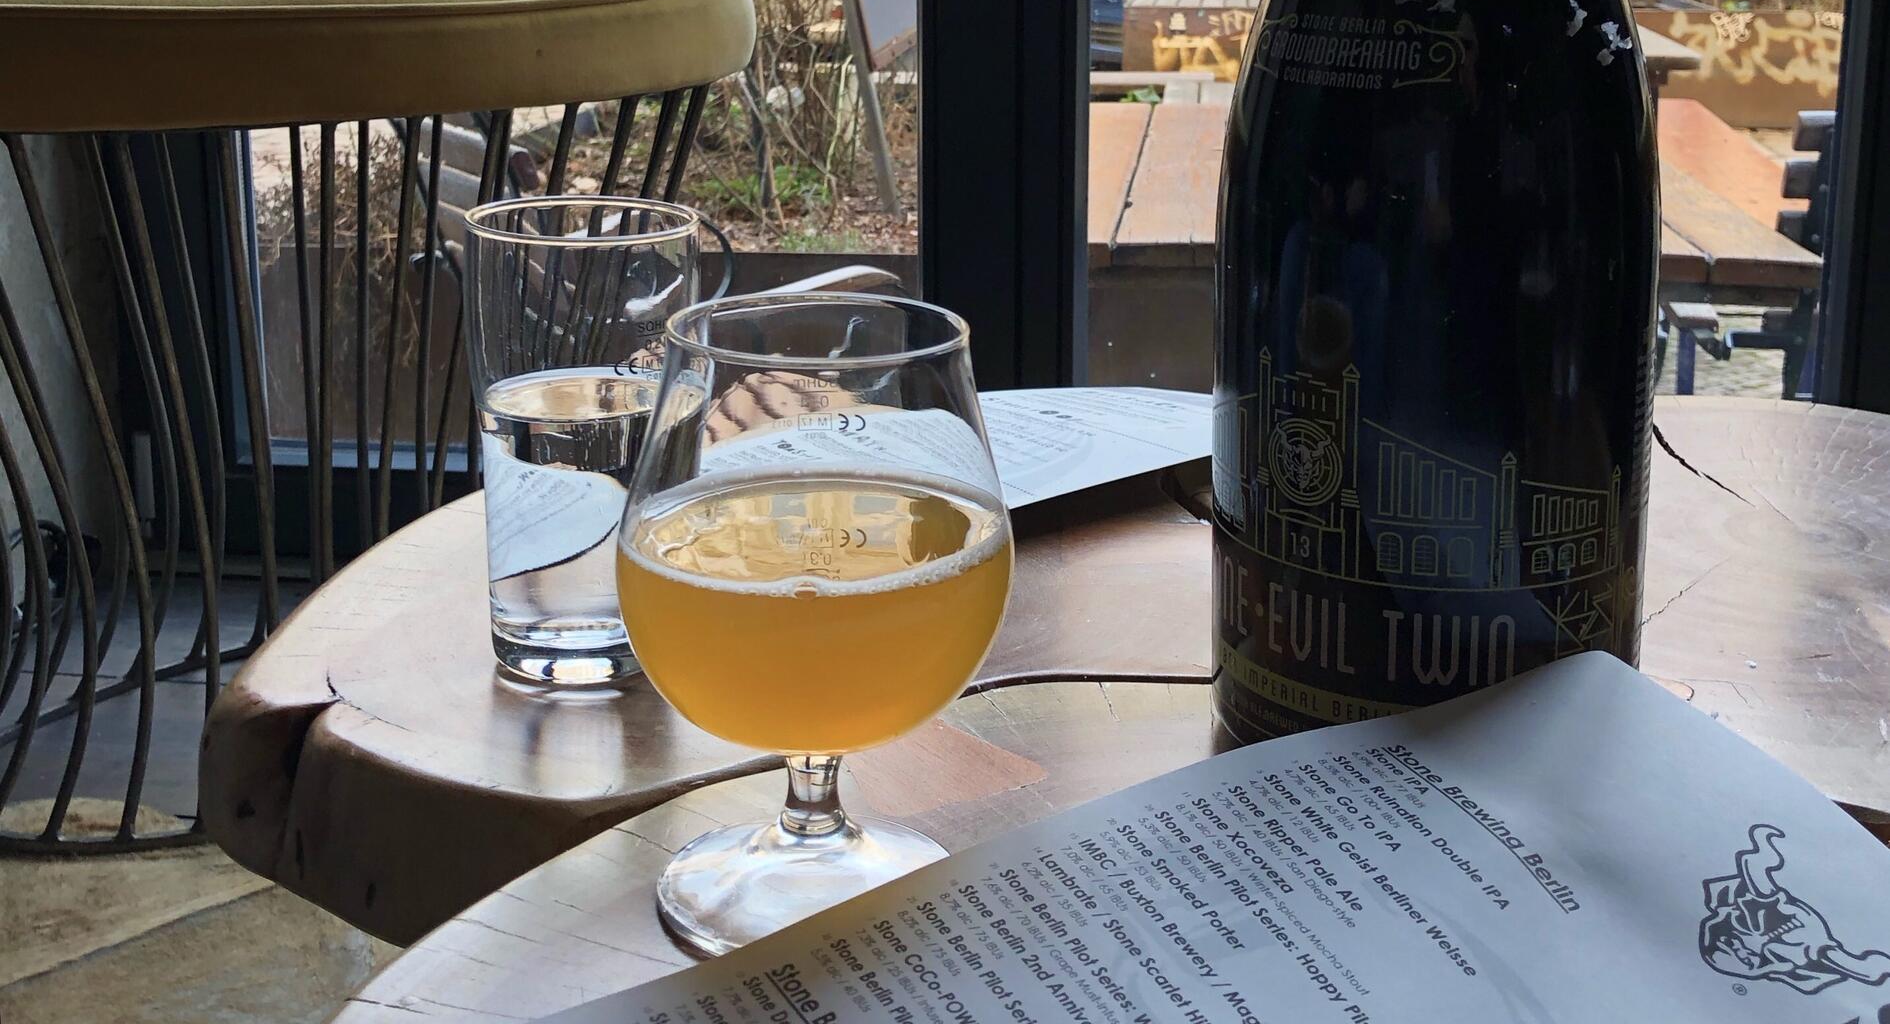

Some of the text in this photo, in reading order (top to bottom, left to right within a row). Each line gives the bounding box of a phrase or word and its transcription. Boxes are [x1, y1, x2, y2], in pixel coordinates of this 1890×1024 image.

[1270, 31, 1421, 71] GROUNDBREAKING
[1301, 14, 1385, 34] STONE BERLIN
[1283, 66, 1383, 89] COLLABORATIONS
[1290, 531, 1310, 558] 13
[1215, 543, 1515, 686] NE EVIL TWIN
[1244, 663, 1318, 713] IMPERIAL
[1299, 764, 1401, 851] Stone Go To IPA
[1366, 748, 1429, 795] Stone IPA
[1192, 798, 1229, 831] Stone
[1226, 832, 1294, 894] Xocoveza
[1228, 785, 1363, 912] Stone Ripper Pale Ale
[1264, 774, 1477, 977] Stone White Geist Berliner Weisse
[1333, 756, 1510, 910] Stone Ruination Double IPA
[1388, 744, 1580, 912] Stone Brewing Berlin
[1078, 838, 1117, 870] IMBC
[1119, 879, 1164, 922] Buxton
[1161, 922, 1218, 977] Brewery
[1117, 824, 1246, 950] Stone Smoked Porter
[1154, 811, 1369, 1024] Stone Berlin Pilot Series: Hoppy Pil
[1286, 862, 1306, 879] San
[1304, 879, 1356, 929] Diego-style
[830, 938, 864, 972] Stone
[859, 972, 894, 1007] Berlin
[874, 920, 979, 1024] Stone CoCo-POW
[917, 902, 951, 935] Stone
[948, 935, 984, 971] Berlin
[979, 971, 1014, 999] Pilot
[958, 885, 1091, 1024] Stone Berlin 2nd Anniv
[1000, 869, 1035, 903] Stone
[1032, 903, 1069, 938] Berlin
[1064, 938, 1099, 967] Pilot
[1091, 967, 1136, 1013] Series:
[1039, 853, 1097, 910] Lambrate
[1103, 918, 1142, 957] Stone
[1139, 957, 1193, 1008] Scarlet
[1184, 1009, 1211, 1024] Hi
[1307, 934, 1343, 970] Mocha
[1341, 969, 1371, 996] Stout
[697, 996, 728, 1024] Ston
[743, 976, 775, 1012] Stone
[772, 963, 820, 1013] Stone
